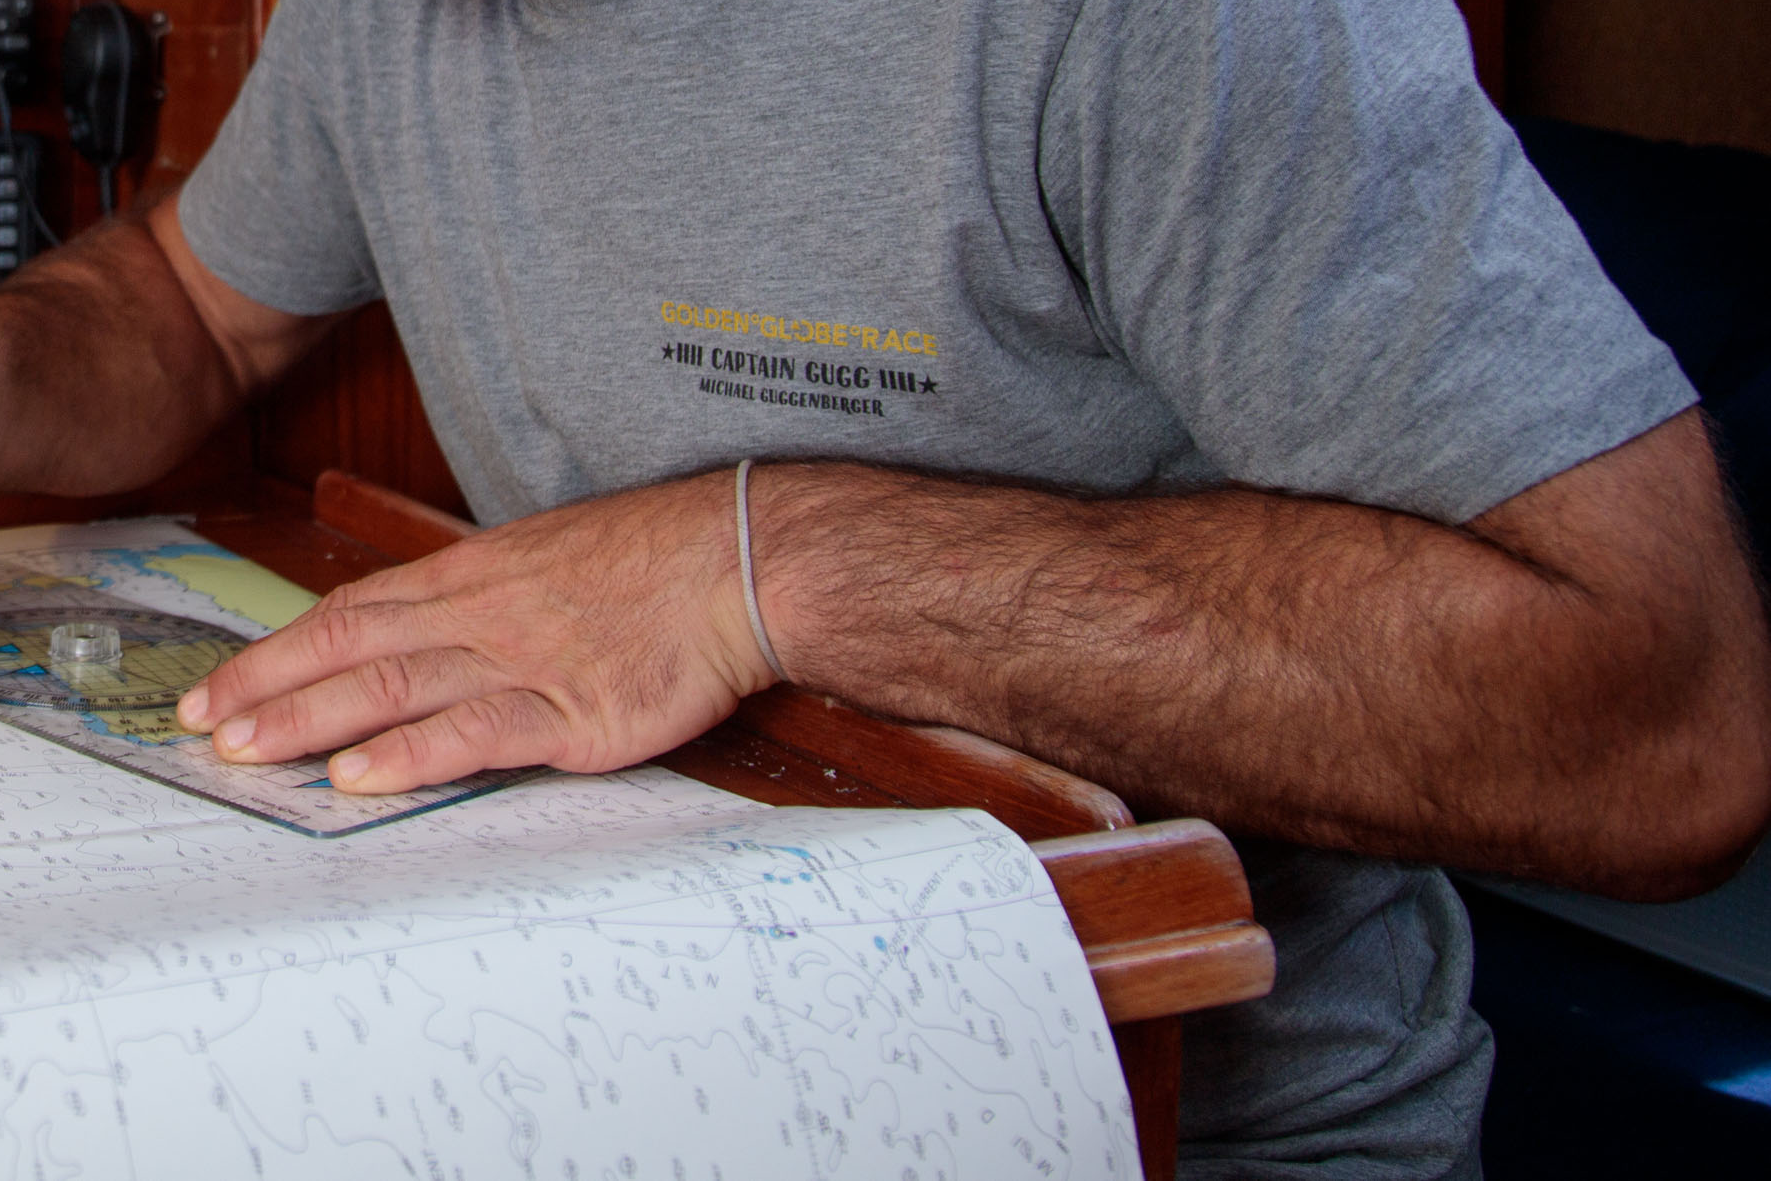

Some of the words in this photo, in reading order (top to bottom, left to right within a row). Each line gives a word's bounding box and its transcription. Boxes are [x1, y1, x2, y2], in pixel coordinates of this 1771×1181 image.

[661, 301, 749, 334] GOLDEN
[862, 327, 939, 356] RACE
[712, 348, 796, 380] CAPTAIN
[805, 361, 870, 390] GUGG
[699, 377, 755, 401] MICHAEL
[760, 387, 885, 418] GUGGENBERGER
